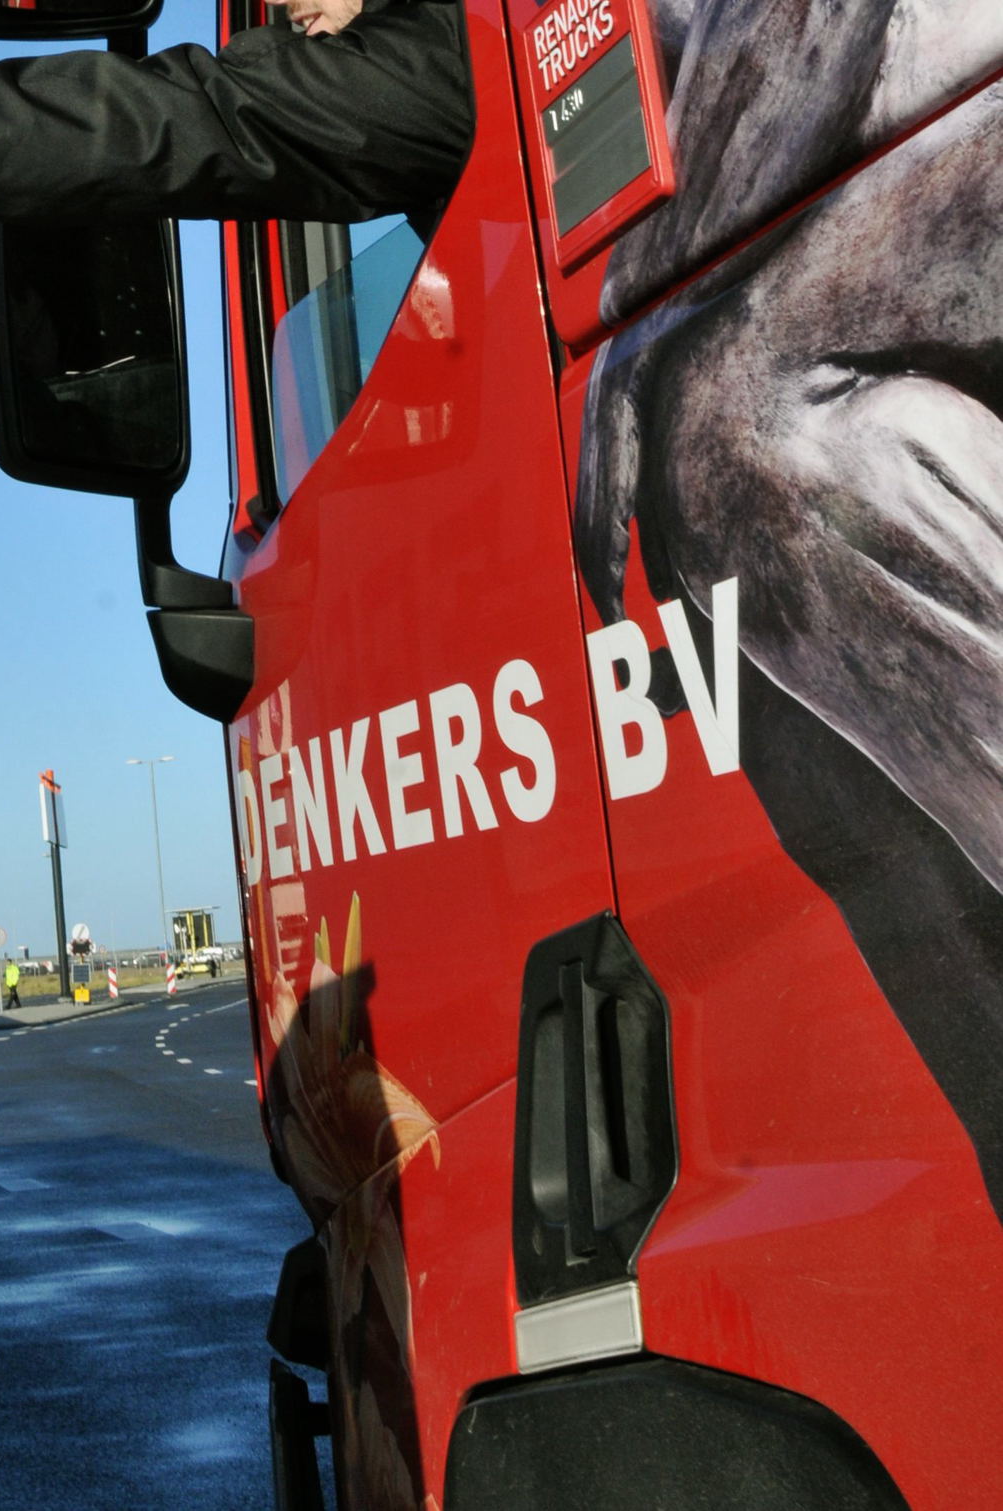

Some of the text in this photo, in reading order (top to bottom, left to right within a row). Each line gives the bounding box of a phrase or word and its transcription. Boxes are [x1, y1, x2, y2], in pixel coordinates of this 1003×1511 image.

[538, 0, 614, 90] TRUCKS
[237, 576, 740, 886] DENKERS BV
